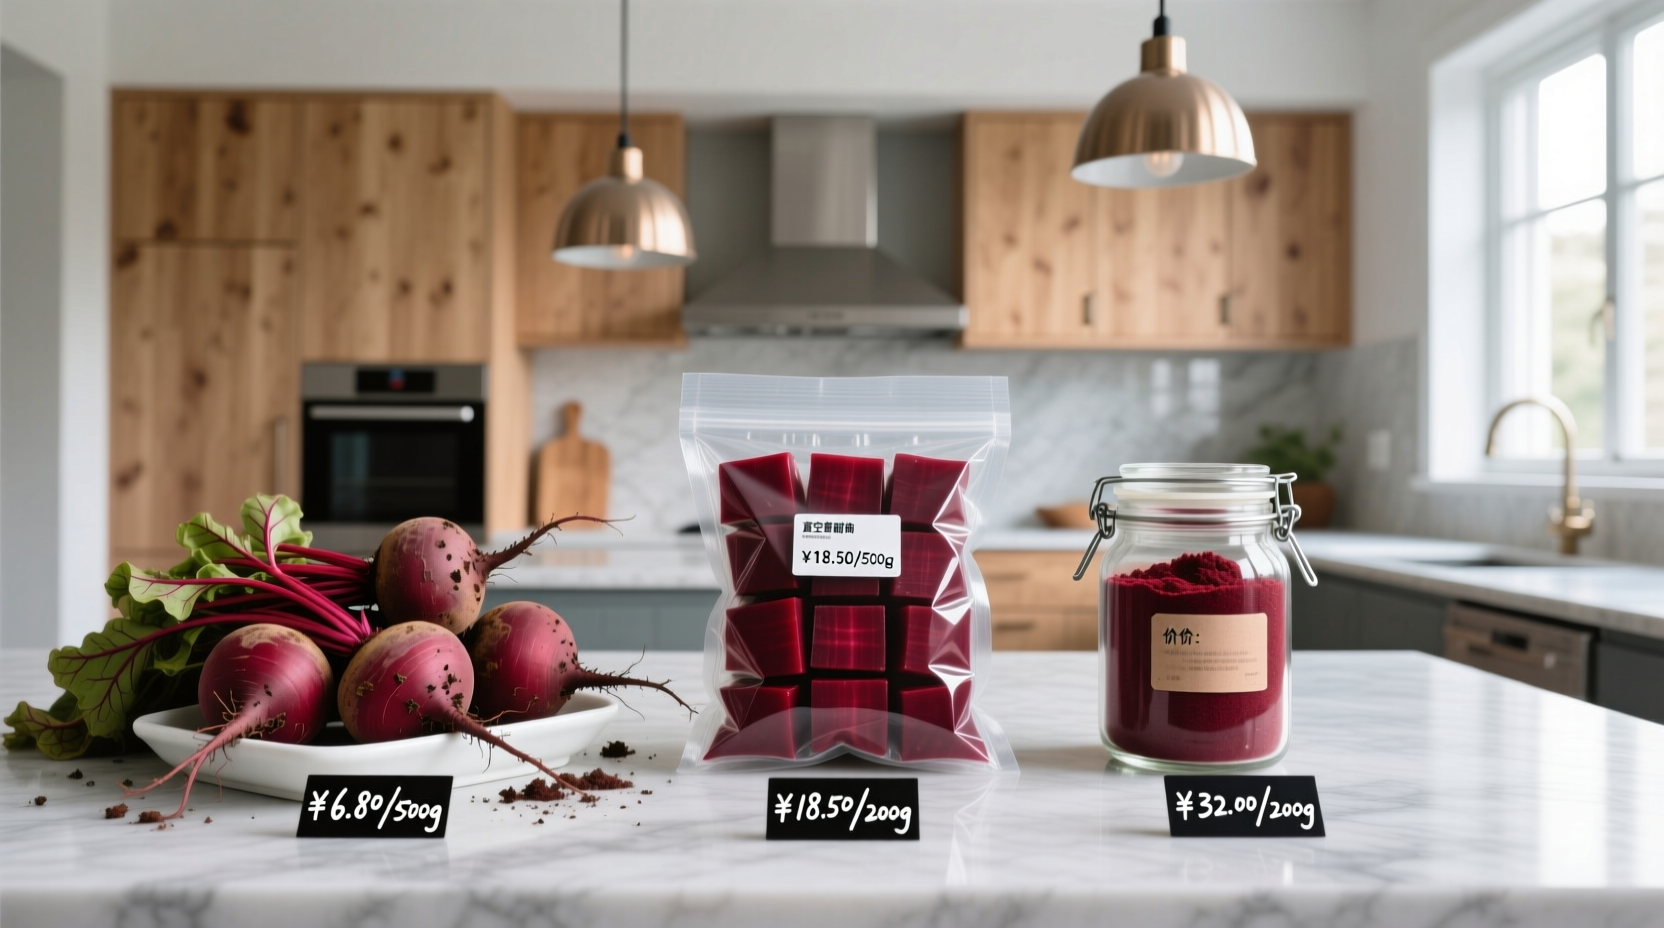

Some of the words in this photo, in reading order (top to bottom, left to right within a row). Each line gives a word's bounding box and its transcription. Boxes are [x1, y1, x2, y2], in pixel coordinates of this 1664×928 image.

[802, 550, 894, 569] ¥18.50/500g
[308, 786, 442, 833] ¥6.80/500g
[774, 787, 911, 834] ¥18.50/200g
[1176, 785, 1315, 830] ¥32.00/200g
